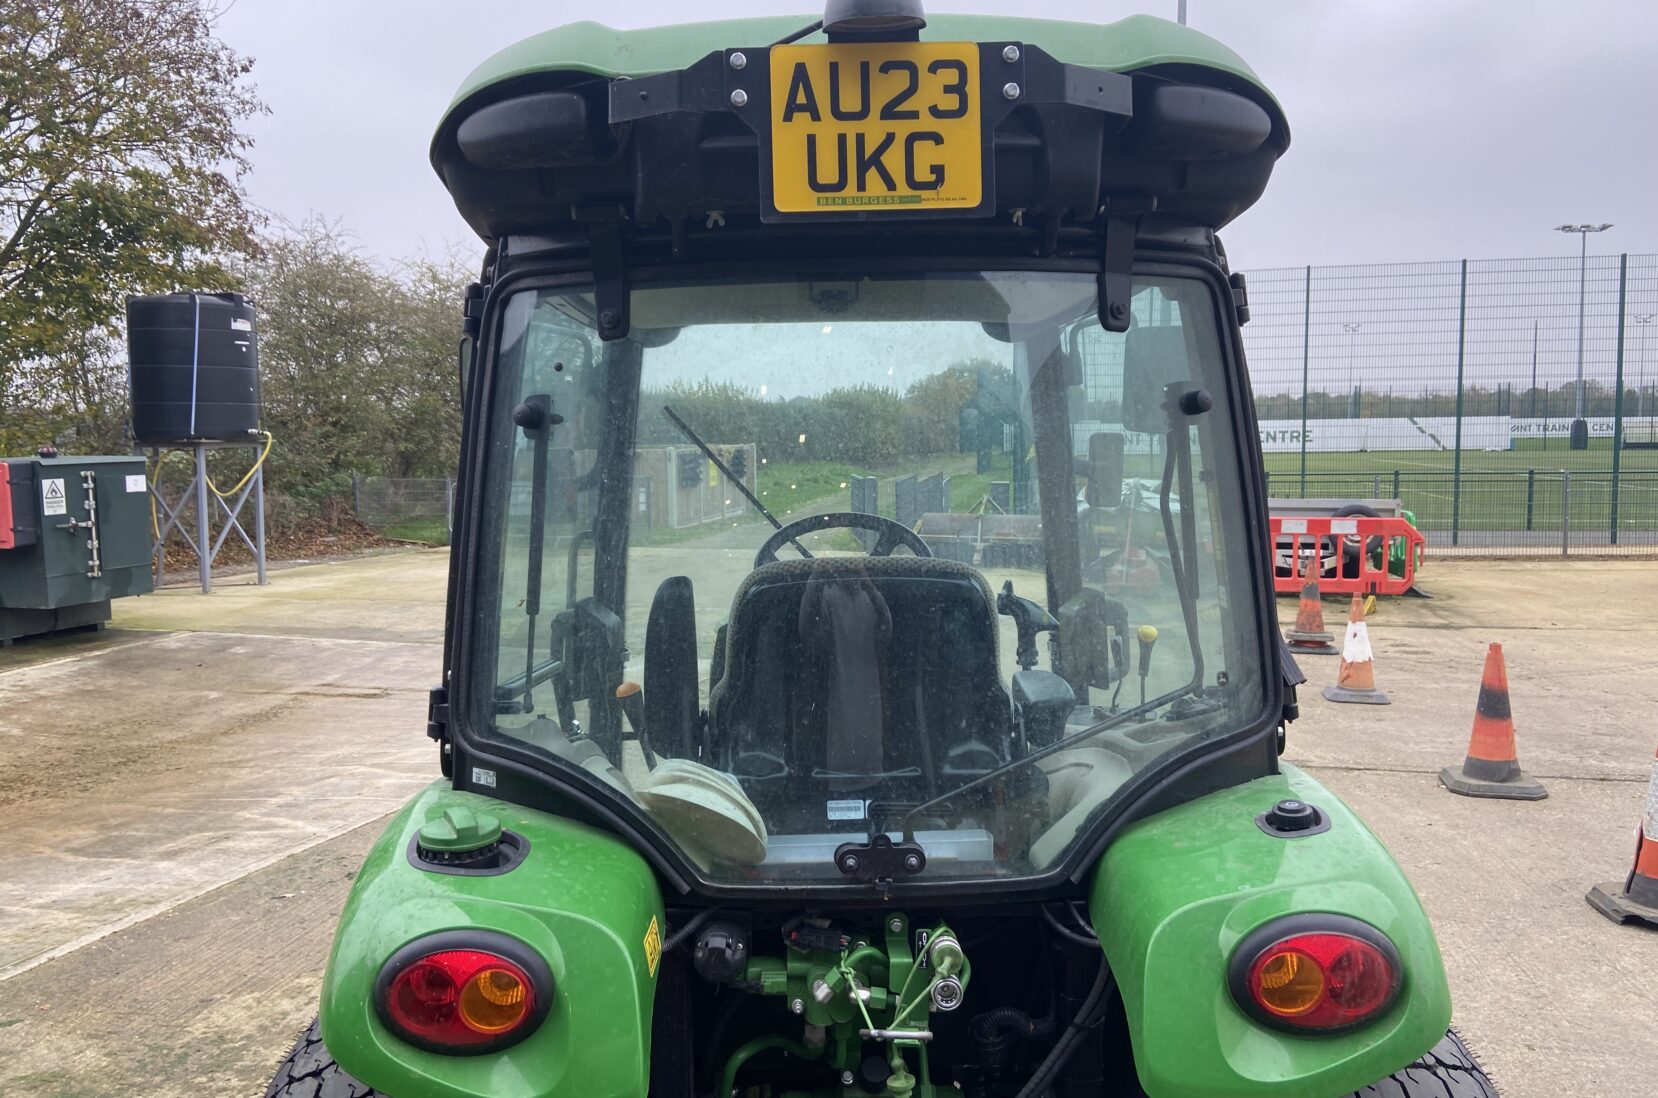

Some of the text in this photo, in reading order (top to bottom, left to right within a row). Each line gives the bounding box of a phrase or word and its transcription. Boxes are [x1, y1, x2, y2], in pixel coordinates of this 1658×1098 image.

[782, 59, 969, 122] AU23
[806, 131, 946, 193] UKG
[819, 197, 842, 206] BEN
[846, 196, 901, 205] BURGESS
[1536, 423, 1569, 432] TRAIN
[1259, 430, 1313, 443] ENTRE
